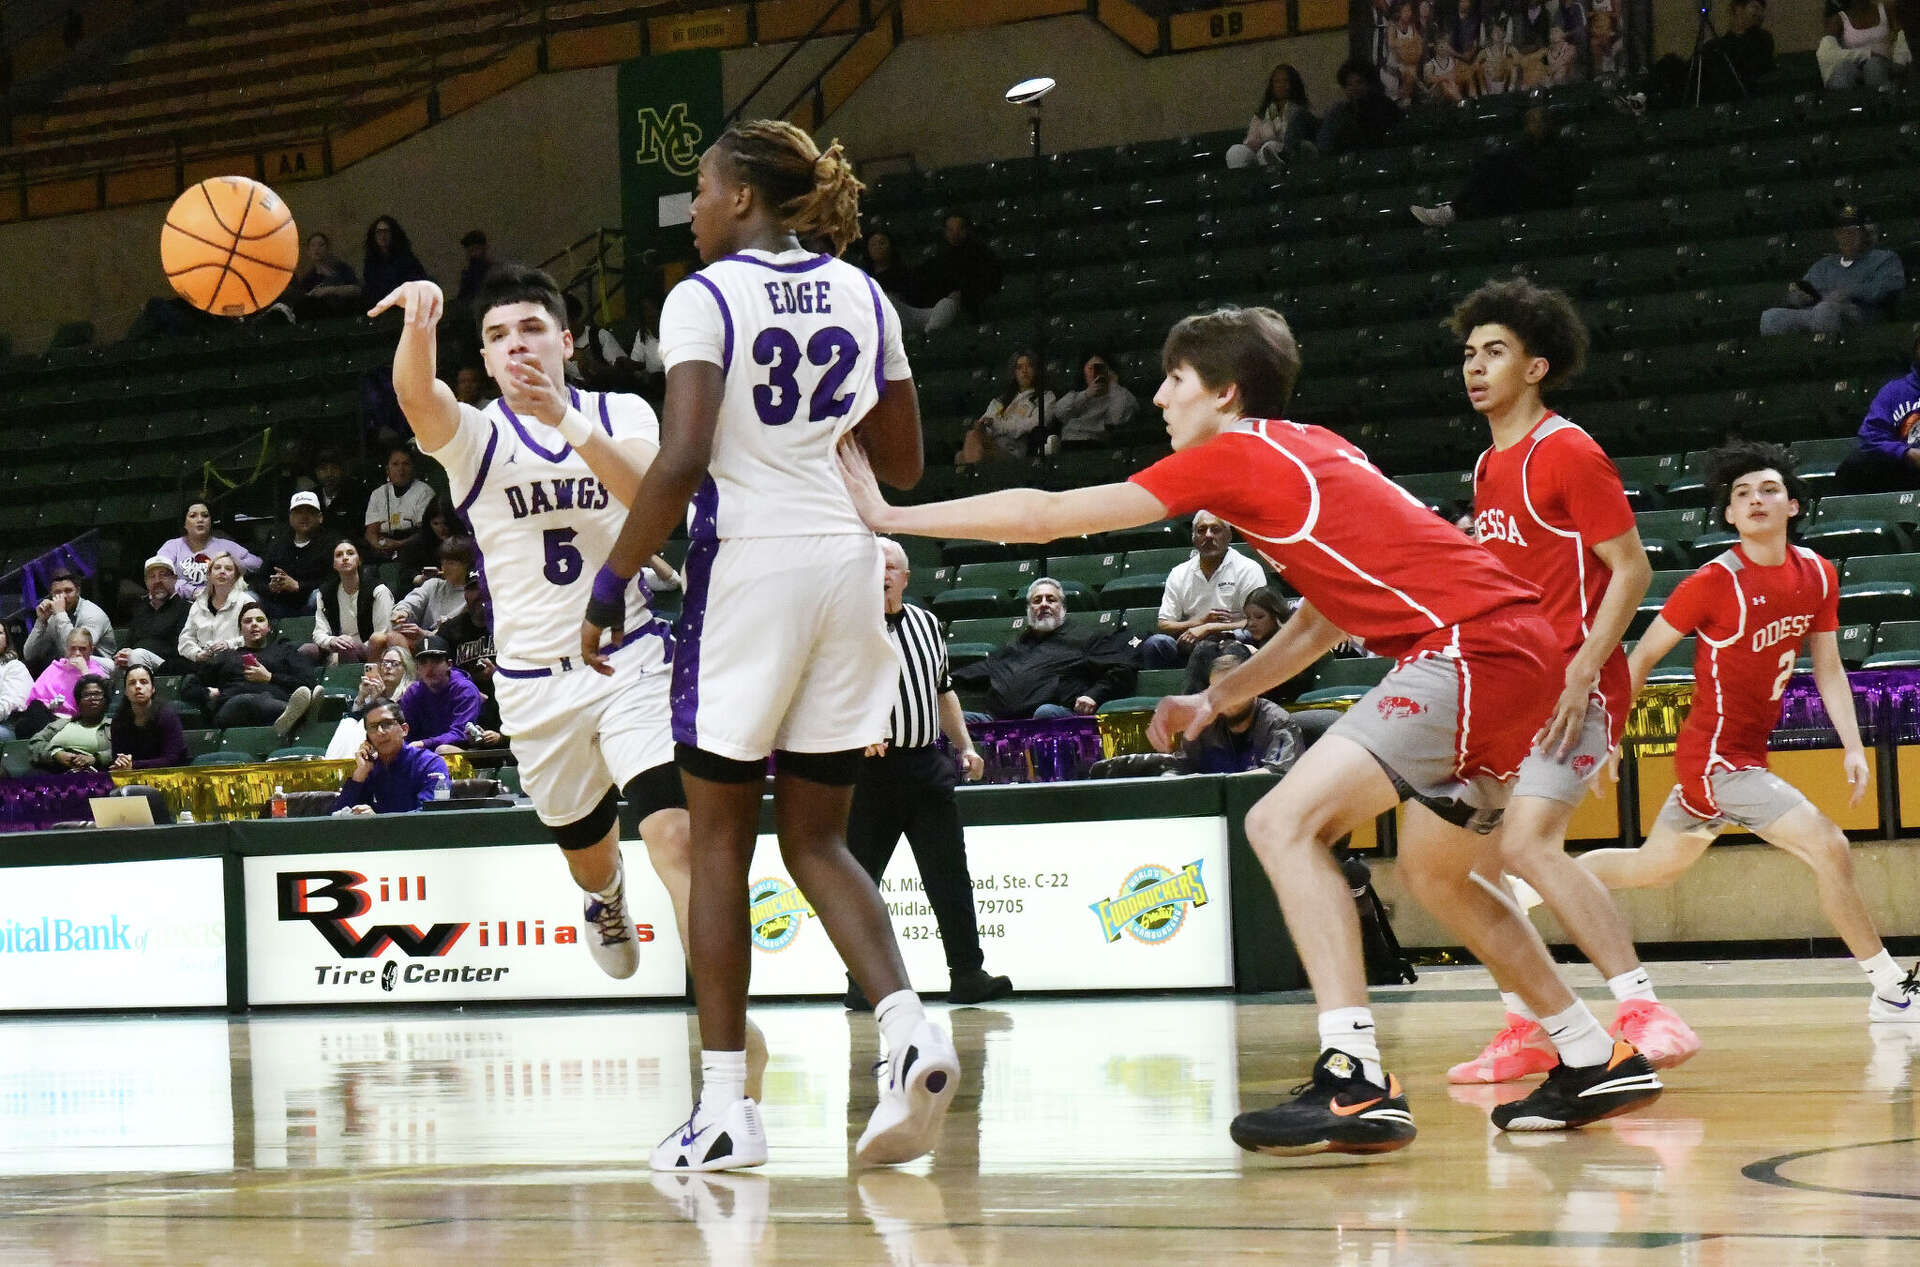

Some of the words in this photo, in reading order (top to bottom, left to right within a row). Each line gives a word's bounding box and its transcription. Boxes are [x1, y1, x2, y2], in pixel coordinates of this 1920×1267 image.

[637, 102, 702, 177] MC
[764, 281, 832, 314] EDGE
[752, 326, 860, 426] 32
[504, 477, 609, 519] DAWGS
[1474, 508, 1528, 547] ESSA
[543, 526, 584, 586] 5
[1768, 648, 1796, 701] 2
[277, 870, 427, 921] Bill
[881, 878, 896, 893] N.
[1003, 874, 1031, 889] Ste.
[1035, 873, 1069, 888] C-22
[1098, 864, 1206, 942] FUDDRUCKERS
[978, 900, 1023, 914] 79705
[54, 913, 131, 952] Bank
[309, 917, 656, 959] Willias
[314, 966, 375, 985] Tire
[403, 963, 510, 983] Center
